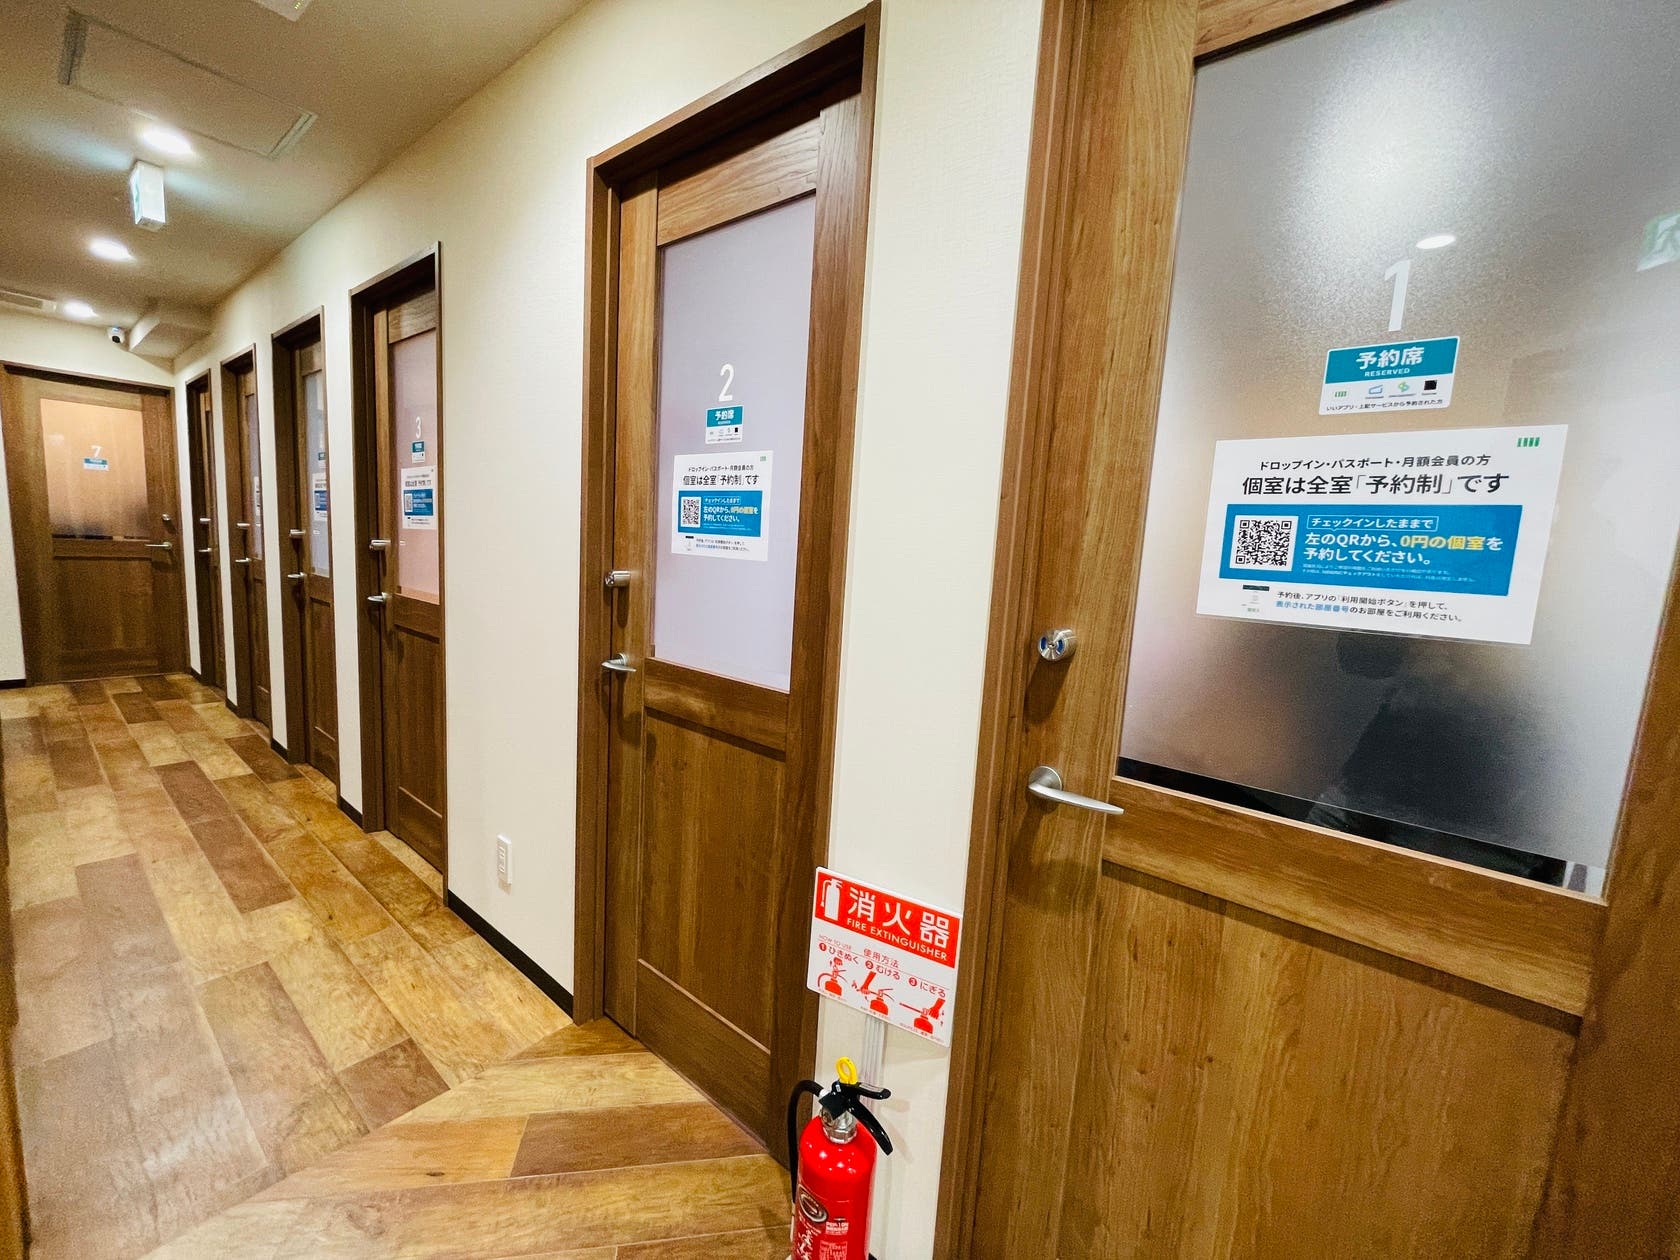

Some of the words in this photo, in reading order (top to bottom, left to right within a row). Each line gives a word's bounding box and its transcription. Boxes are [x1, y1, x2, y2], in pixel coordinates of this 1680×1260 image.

[1384, 259, 1411, 332] 1
[1356, 346, 1425, 370] 予約席
[718, 363, 735, 402] 2
[1364, 367, 1411, 377] RESERVED
[415, 416, 422, 439] 3
[1259, 454, 1492, 471] ドロップイン・パスポート・月額会員の方
[1242, 472, 1510, 495] 個室は全室「予約制」です
[1311, 517, 1434, 529] チェックインしたままで
[1304, 532, 1504, 551] 左のQRから、0円の個室を
[1303, 548, 1431, 565] 予約してください。
[847, 886, 950, 949] 消火器
[847, 917, 867, 932] FIRE
[870, 926, 948, 961] EXTINGUISHER
[828, 945, 859, 965] ひきぬく
[863, 948, 899, 969] 使用方法
[919, 981, 946, 998] にぎる
